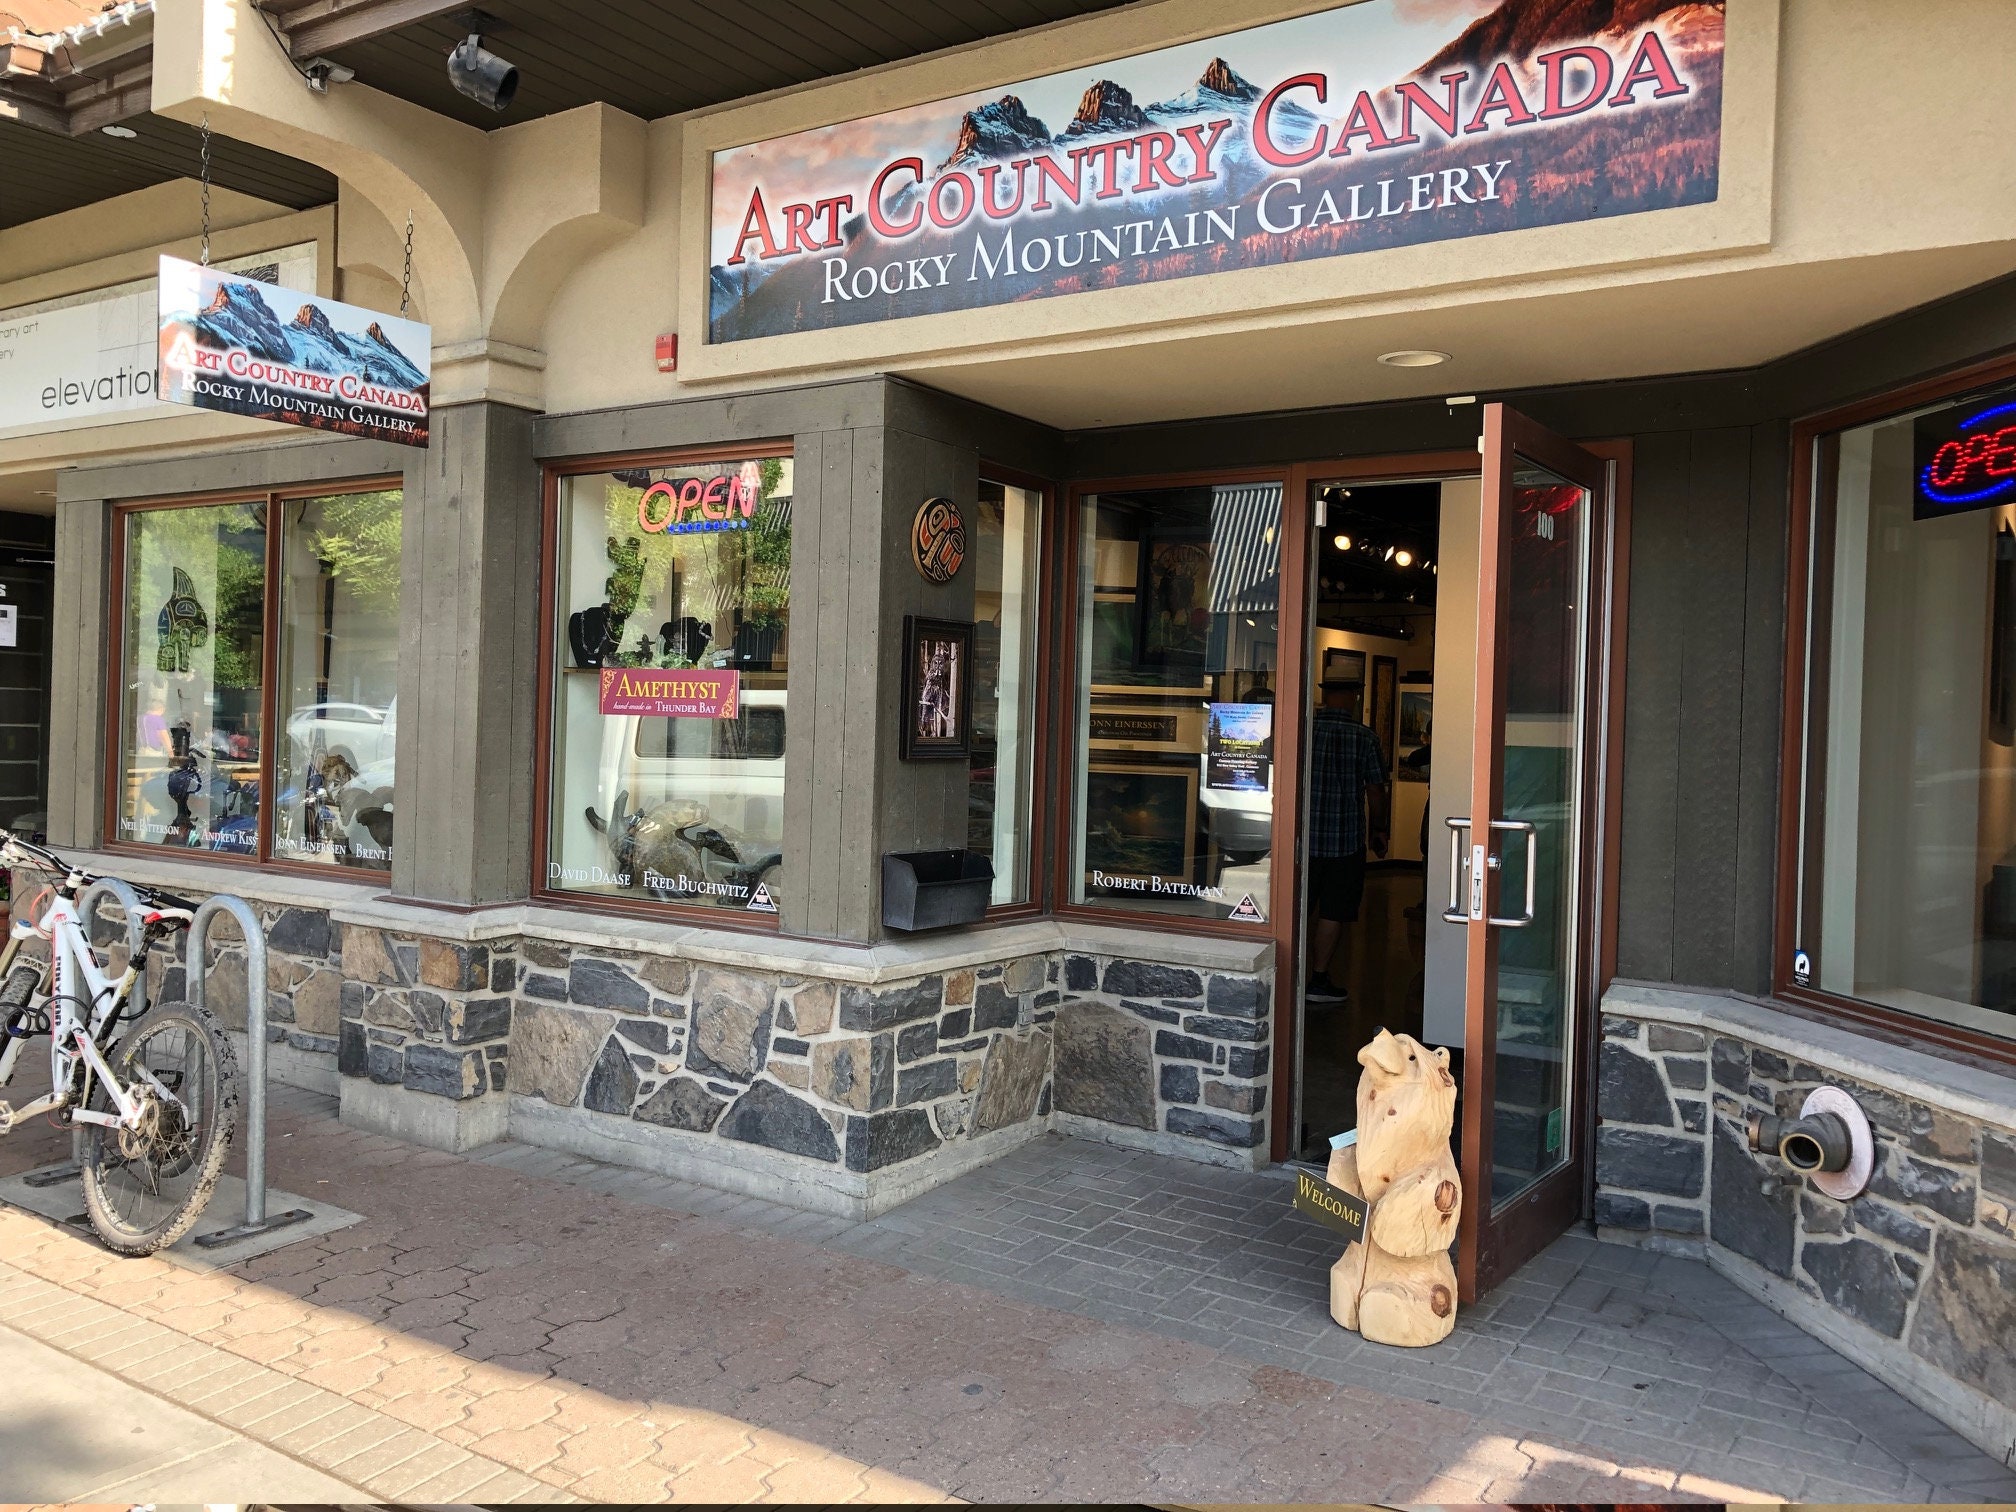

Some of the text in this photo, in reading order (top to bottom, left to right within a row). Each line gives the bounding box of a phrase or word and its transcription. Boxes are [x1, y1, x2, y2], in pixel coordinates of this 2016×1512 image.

[728, 31, 1689, 266] ART COUNTRY CANADA
[821, 160, 1511, 304] ROCKY MOUNTAIN GALLERY
[23, 321, 39, 334] art
[172, 337, 424, 413] ART COUNTRY CANADA
[181, 371, 416, 433] ROCKY MOUNTAIN GALLERY
[638, 475, 760, 533] OPEN
[1537, 511, 1554, 541] 100
[616, 672, 720, 699] AMETHYST
[655, 701, 697, 713] THUNDER
[699, 702, 716, 714] BAY
[120, 817, 137, 831] NEIL
[201, 828, 257, 846] ANDREW KISS
[356, 843, 387, 860] BRENT
[550, 862, 631, 886] DAVID DAASE
[643, 870, 749, 898] FRED BUCHWITZ
[1092, 870, 1224, 898] ROBERT BATEMAN
[1299, 1174, 1361, 1227] WELCOME
